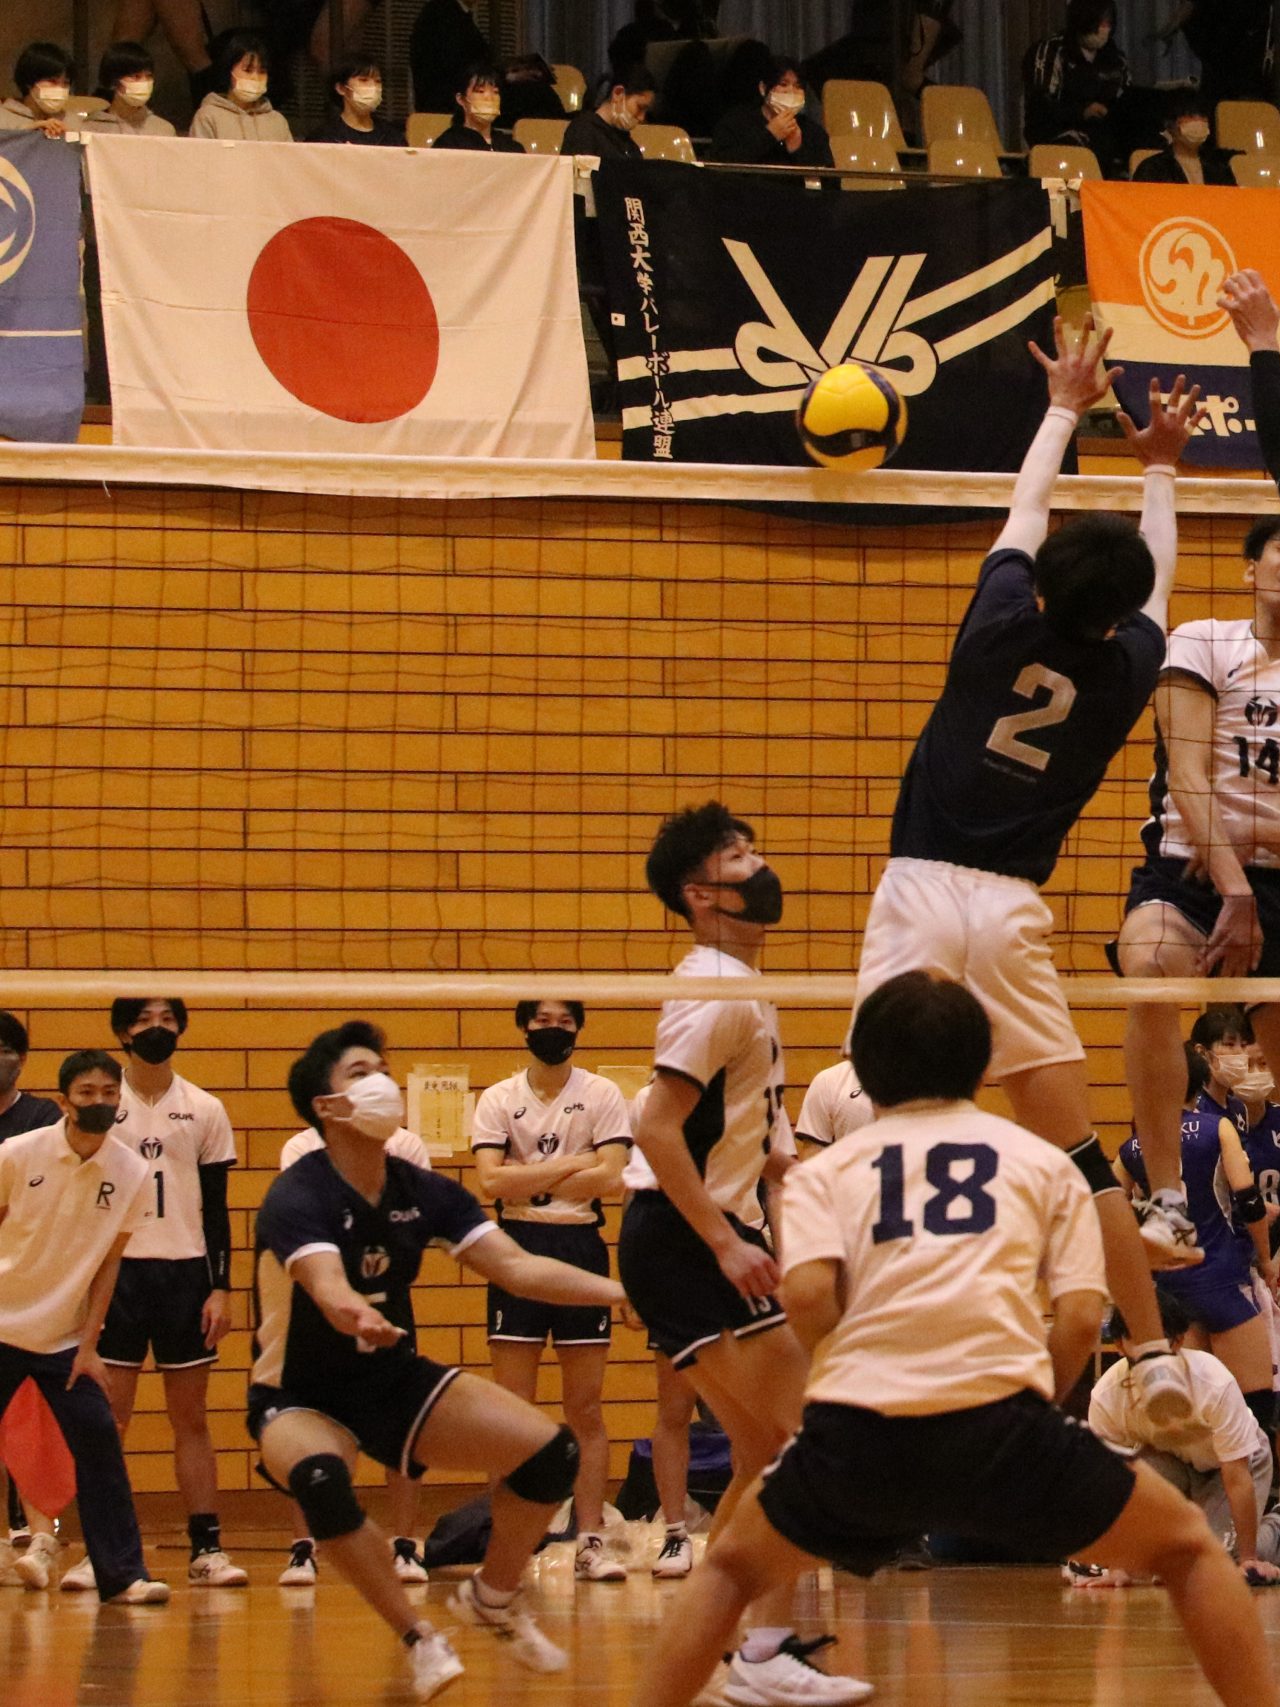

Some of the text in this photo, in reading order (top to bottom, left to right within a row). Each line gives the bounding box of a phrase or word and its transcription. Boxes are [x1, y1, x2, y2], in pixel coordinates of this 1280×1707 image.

[624, 197, 675, 460] 関西大学バレーボール連盟
[986, 663, 1078, 771] 2
[1232, 735, 1280, 784] 14
[96, 1181, 115, 1207] R
[871, 1142, 999, 1246] 18
